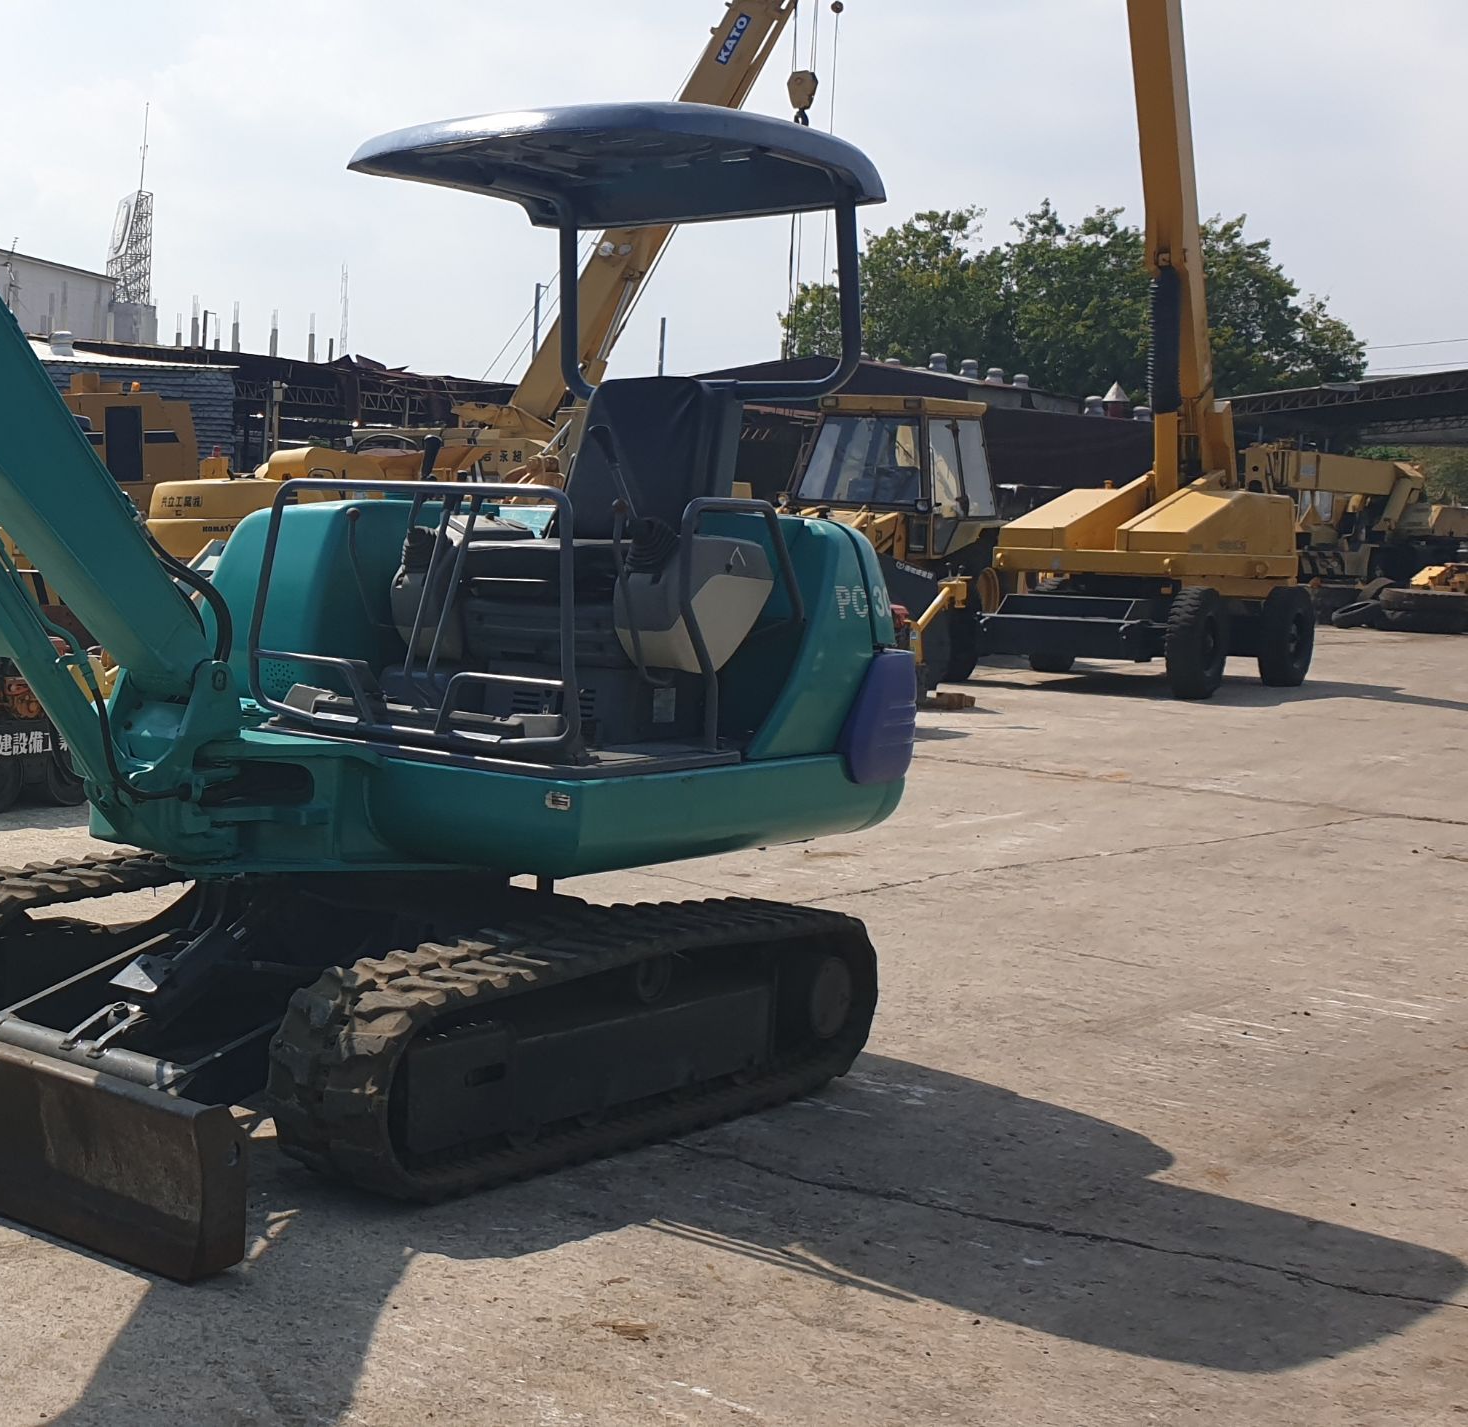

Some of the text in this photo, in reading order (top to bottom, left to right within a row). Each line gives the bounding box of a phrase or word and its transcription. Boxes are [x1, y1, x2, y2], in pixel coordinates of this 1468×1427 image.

[717, 16, 748, 62] KATO
[202, 524, 237, 533] KOMATS
[834, 585, 869, 619] PC
